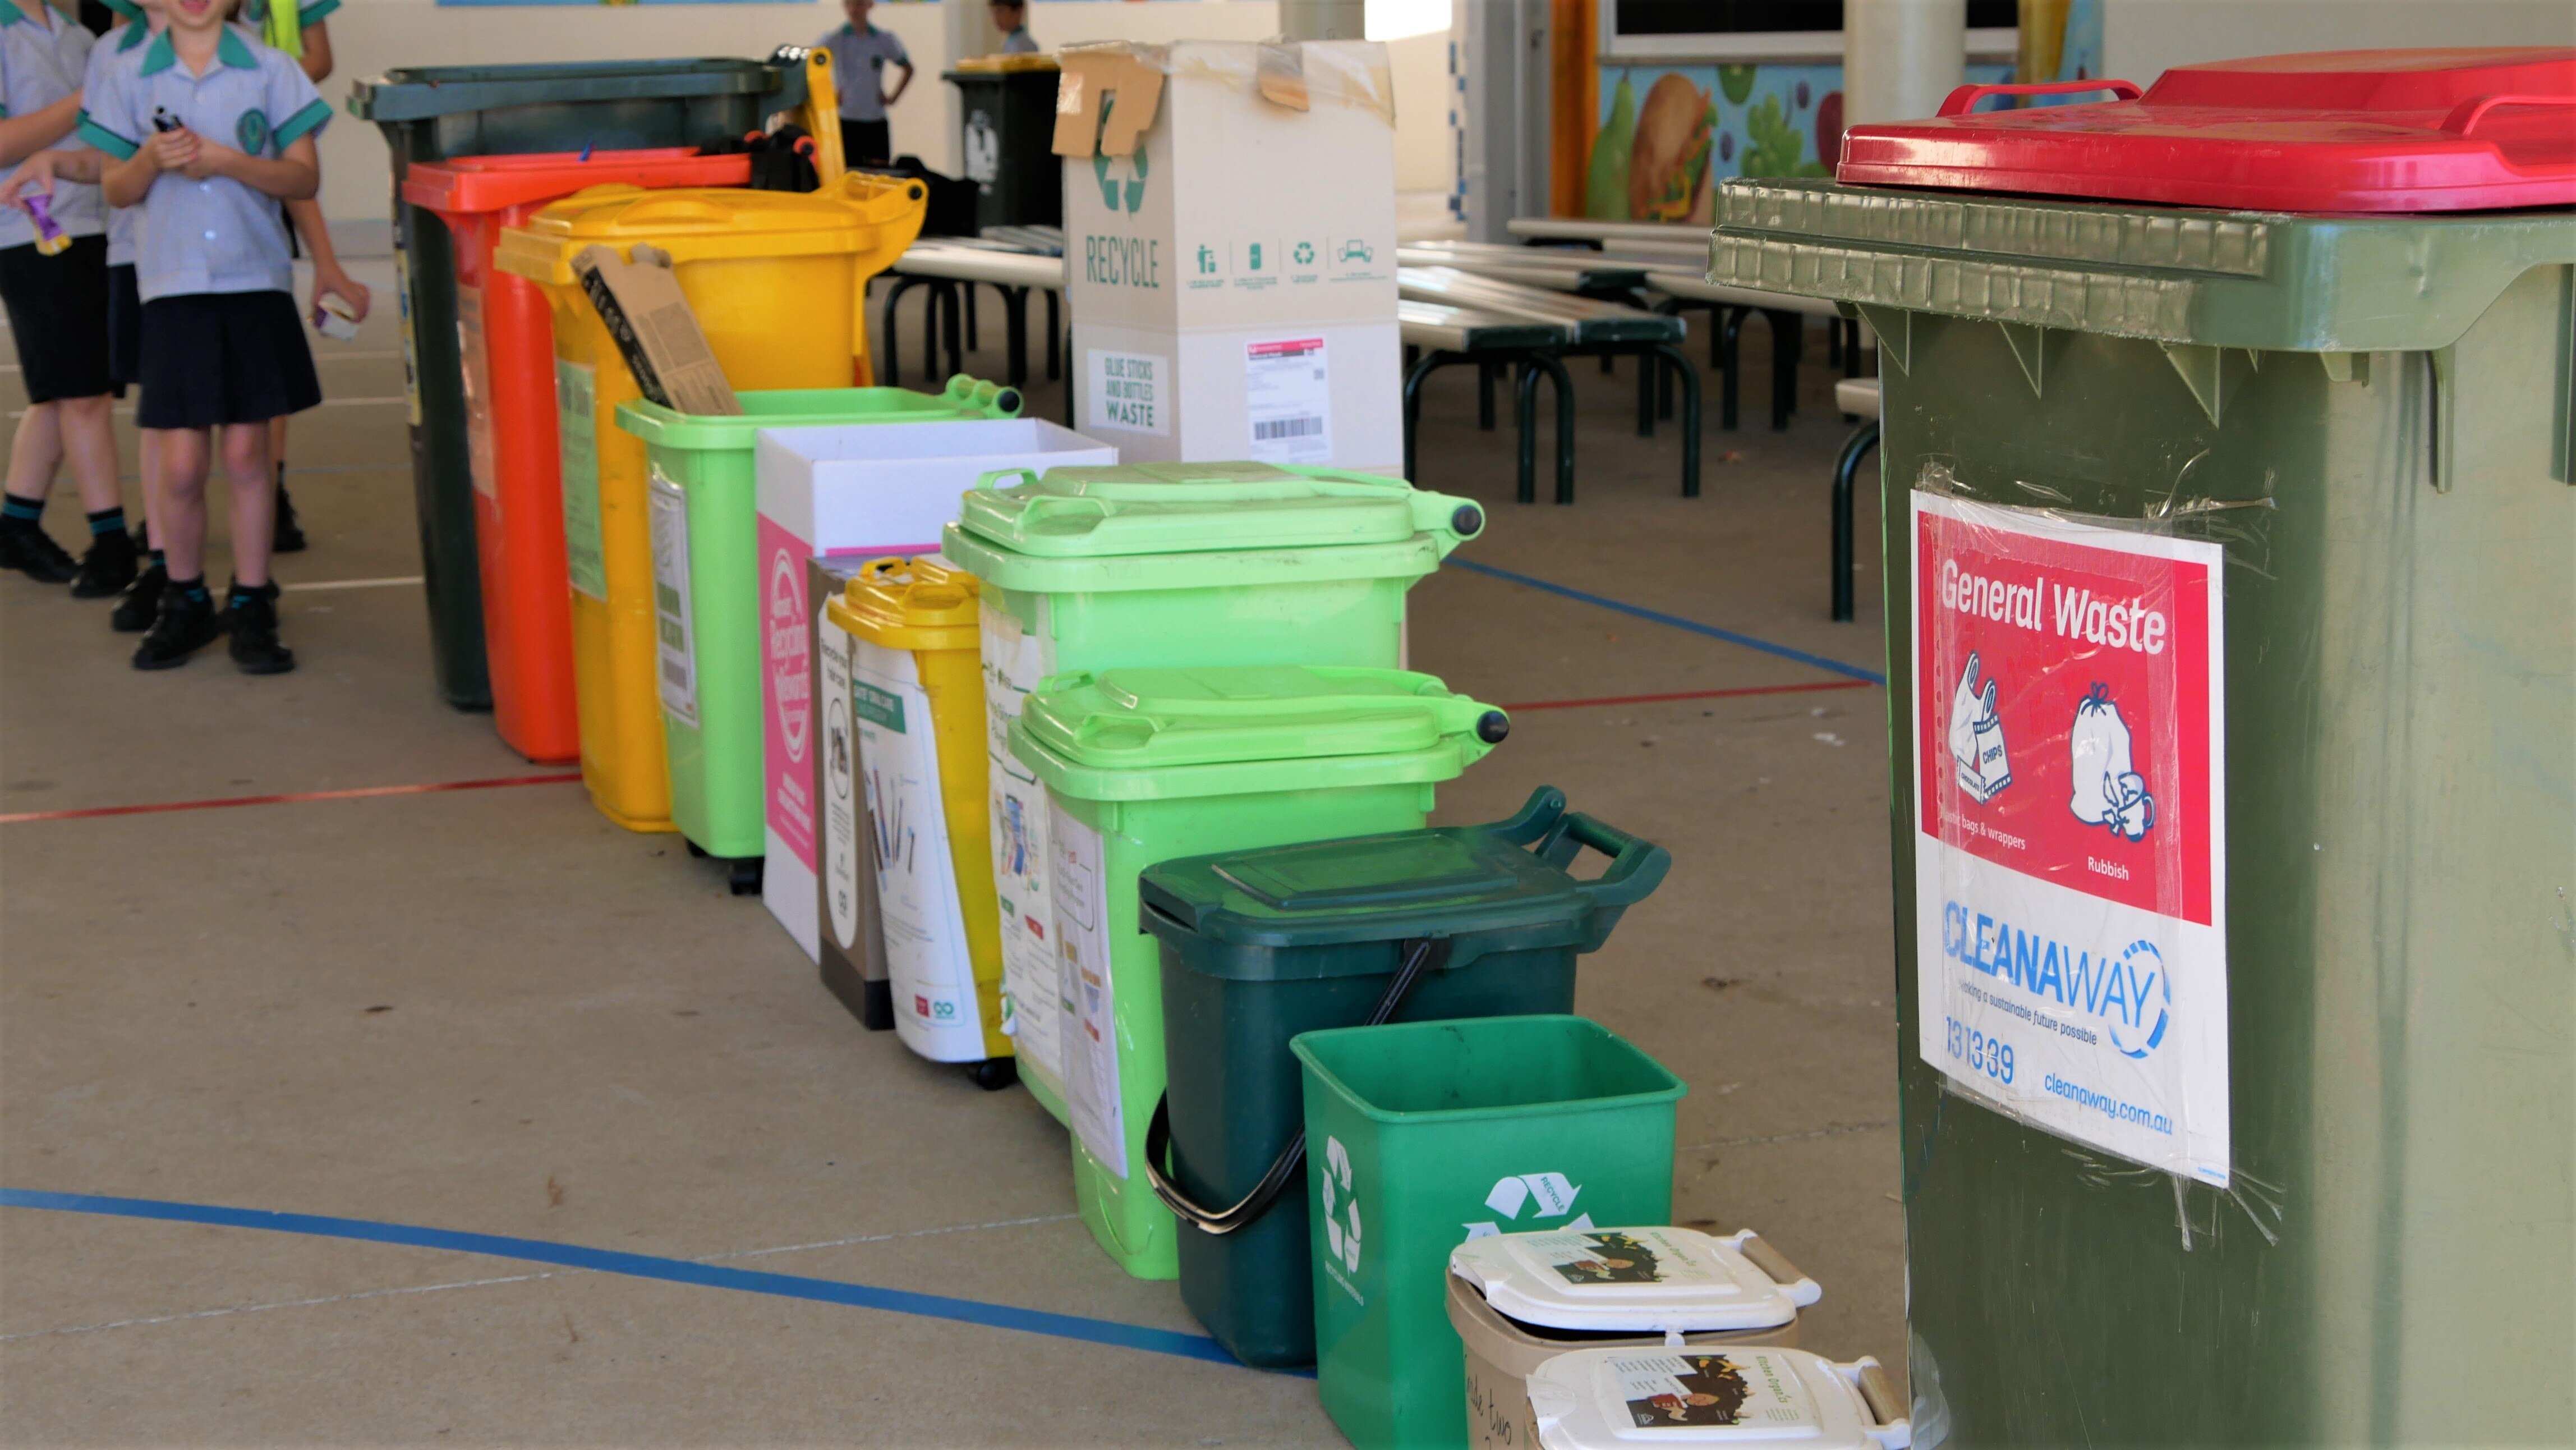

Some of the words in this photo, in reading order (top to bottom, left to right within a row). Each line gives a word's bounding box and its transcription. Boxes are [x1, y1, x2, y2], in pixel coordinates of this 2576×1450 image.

[1086, 235, 1160, 289] RECYCLE
[1105, 357, 1125, 377] GLUE
[1127, 359, 1153, 380] STICKS
[1106, 379, 1121, 397] AND
[1123, 380, 1153, 401] BOTTLES
[1106, 400, 1154, 427] WASTE
[1941, 558, 2043, 632] General
[2053, 583, 2166, 655] Waste
[1982, 744, 2003, 765] CHIPS
[1960, 772, 1980, 792] CHOCOLATE
[1962, 814, 1979, 835] bags
[1980, 822, 1986, 836] &
[1988, 827, 2026, 850] wrappers
[2087, 856, 2129, 882] Rubbish
[1944, 900, 2155, 1028] CLEANAWAY
[1982, 994, 1988, 1003] a
[1989, 994, 2031, 1021] sustainable
[2032, 1010, 2058, 1031] future
[2060, 1022, 2097, 1045] possible
[2044, 1072, 2173, 1136] cleanaway.com.au
[1540, 1176, 1566, 1213] RECYCLE
[1488, 1388, 1512, 1446] two
